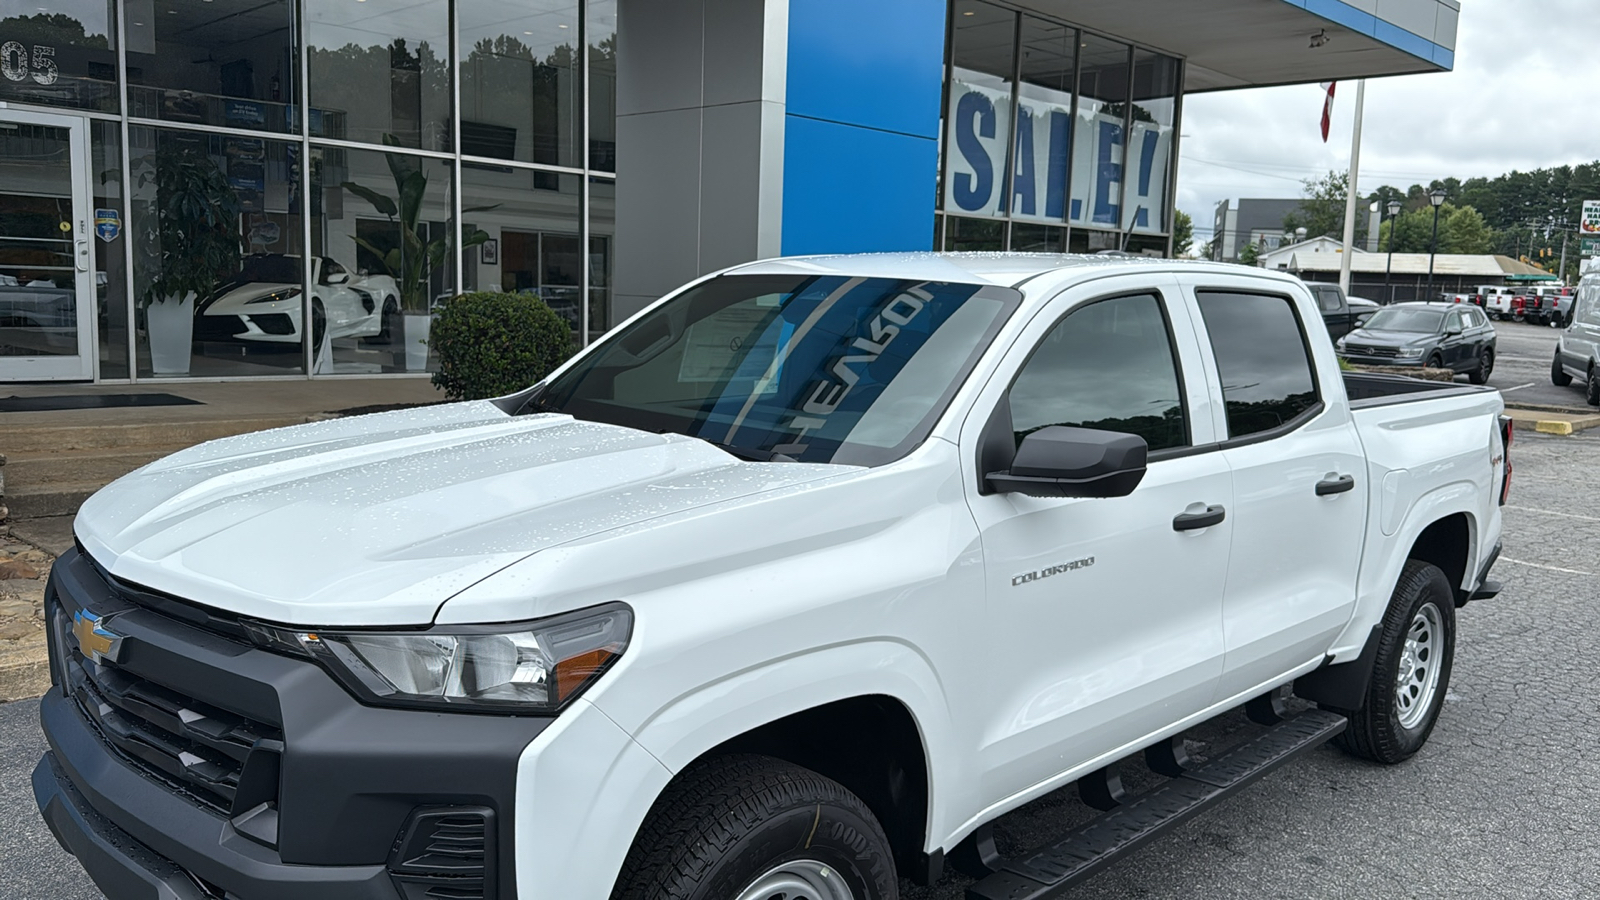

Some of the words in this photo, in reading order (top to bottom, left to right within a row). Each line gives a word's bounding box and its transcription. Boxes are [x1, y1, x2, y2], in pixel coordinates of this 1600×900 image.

[0, 40, 59, 86] 05
[953, 90, 1159, 228] SALE!
[1011, 556, 1095, 587] COLORADO
